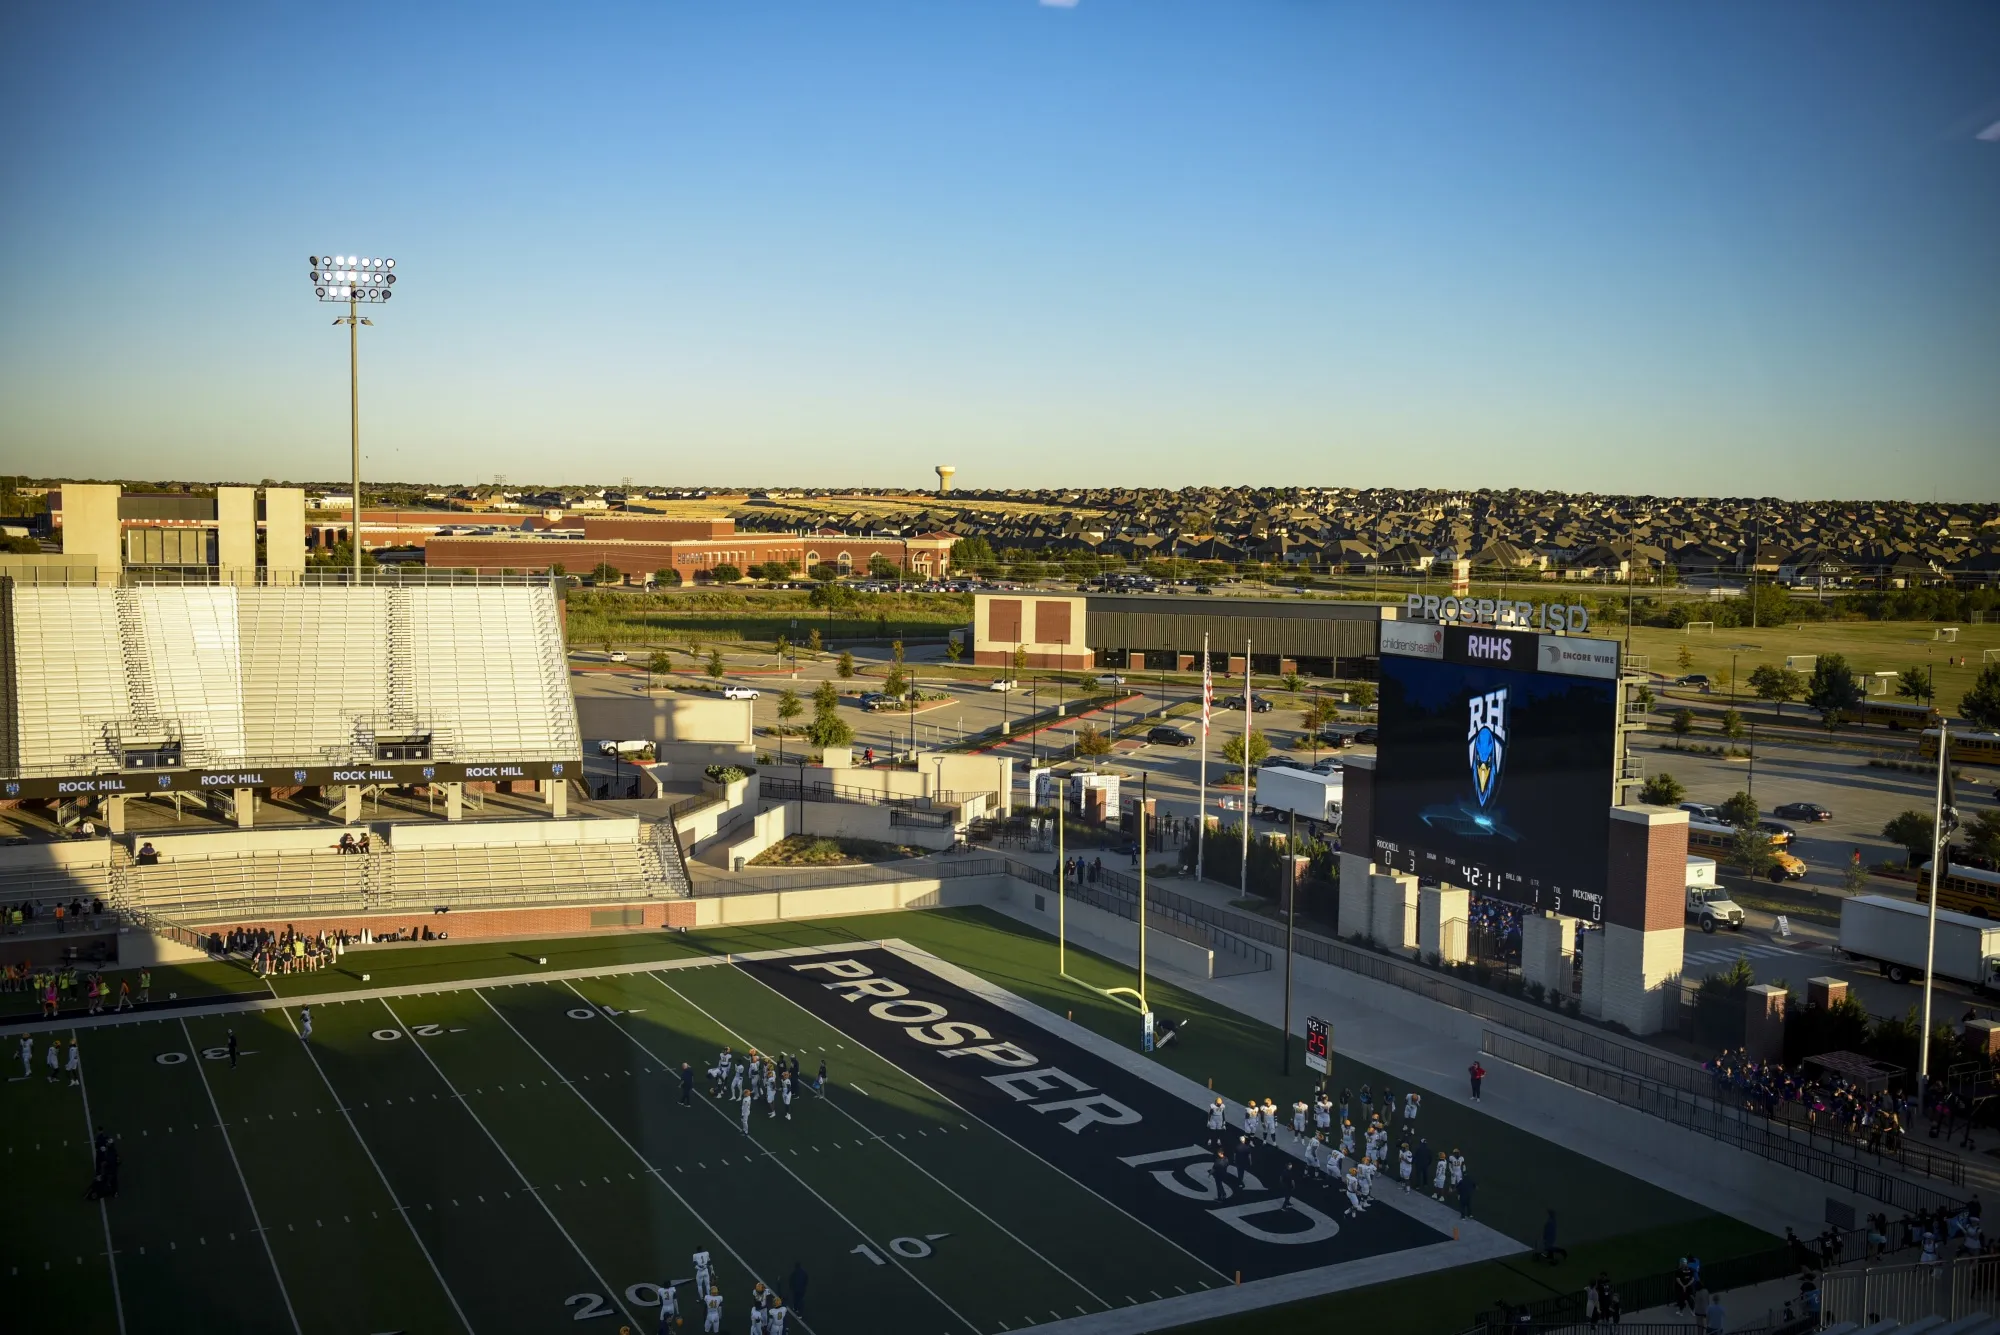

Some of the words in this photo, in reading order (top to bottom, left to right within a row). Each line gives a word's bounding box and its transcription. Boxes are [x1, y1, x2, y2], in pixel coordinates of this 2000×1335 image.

[1407, 593, 1533, 630] PROSPER
[1540, 603, 1589, 633] ISD
[1468, 635, 1512, 661] RHHS
[1563, 652, 1591, 661] ENCORE
[1594, 655, 1614, 664] WIRE
[1468, 688, 1507, 742] RH
[201, 774, 235, 785] ROCK
[239, 773, 264, 783] HILL
[333, 771, 366, 781] ROCK
[369, 770, 394, 780] HILL
[466, 767, 498, 777] ROCK
[500, 766, 524, 776] HILL
[59, 781, 95, 792] ROCK
[99, 780, 126, 790] HILL
[1385, 850, 1392, 865] 0
[1409, 858, 1415, 872] 3
[1462, 865, 1501, 891] 42:11
[1535, 889, 1538, 903] 1
[1553, 886, 1561, 895] TOL
[1572, 889, 1603, 904] MCKINNEY
[1554, 896, 1560, 911] 3
[1592, 904, 1601, 921] 0
[1307, 1019, 1328, 1036] 42:11
[1309, 1031, 1325, 1056] 25
[789, 959, 1143, 1135] PROSPER
[1116, 1144, 1340, 1245] ISD
[850, 1236, 933, 1266] 10
[565, 1282, 663, 1321] 20
